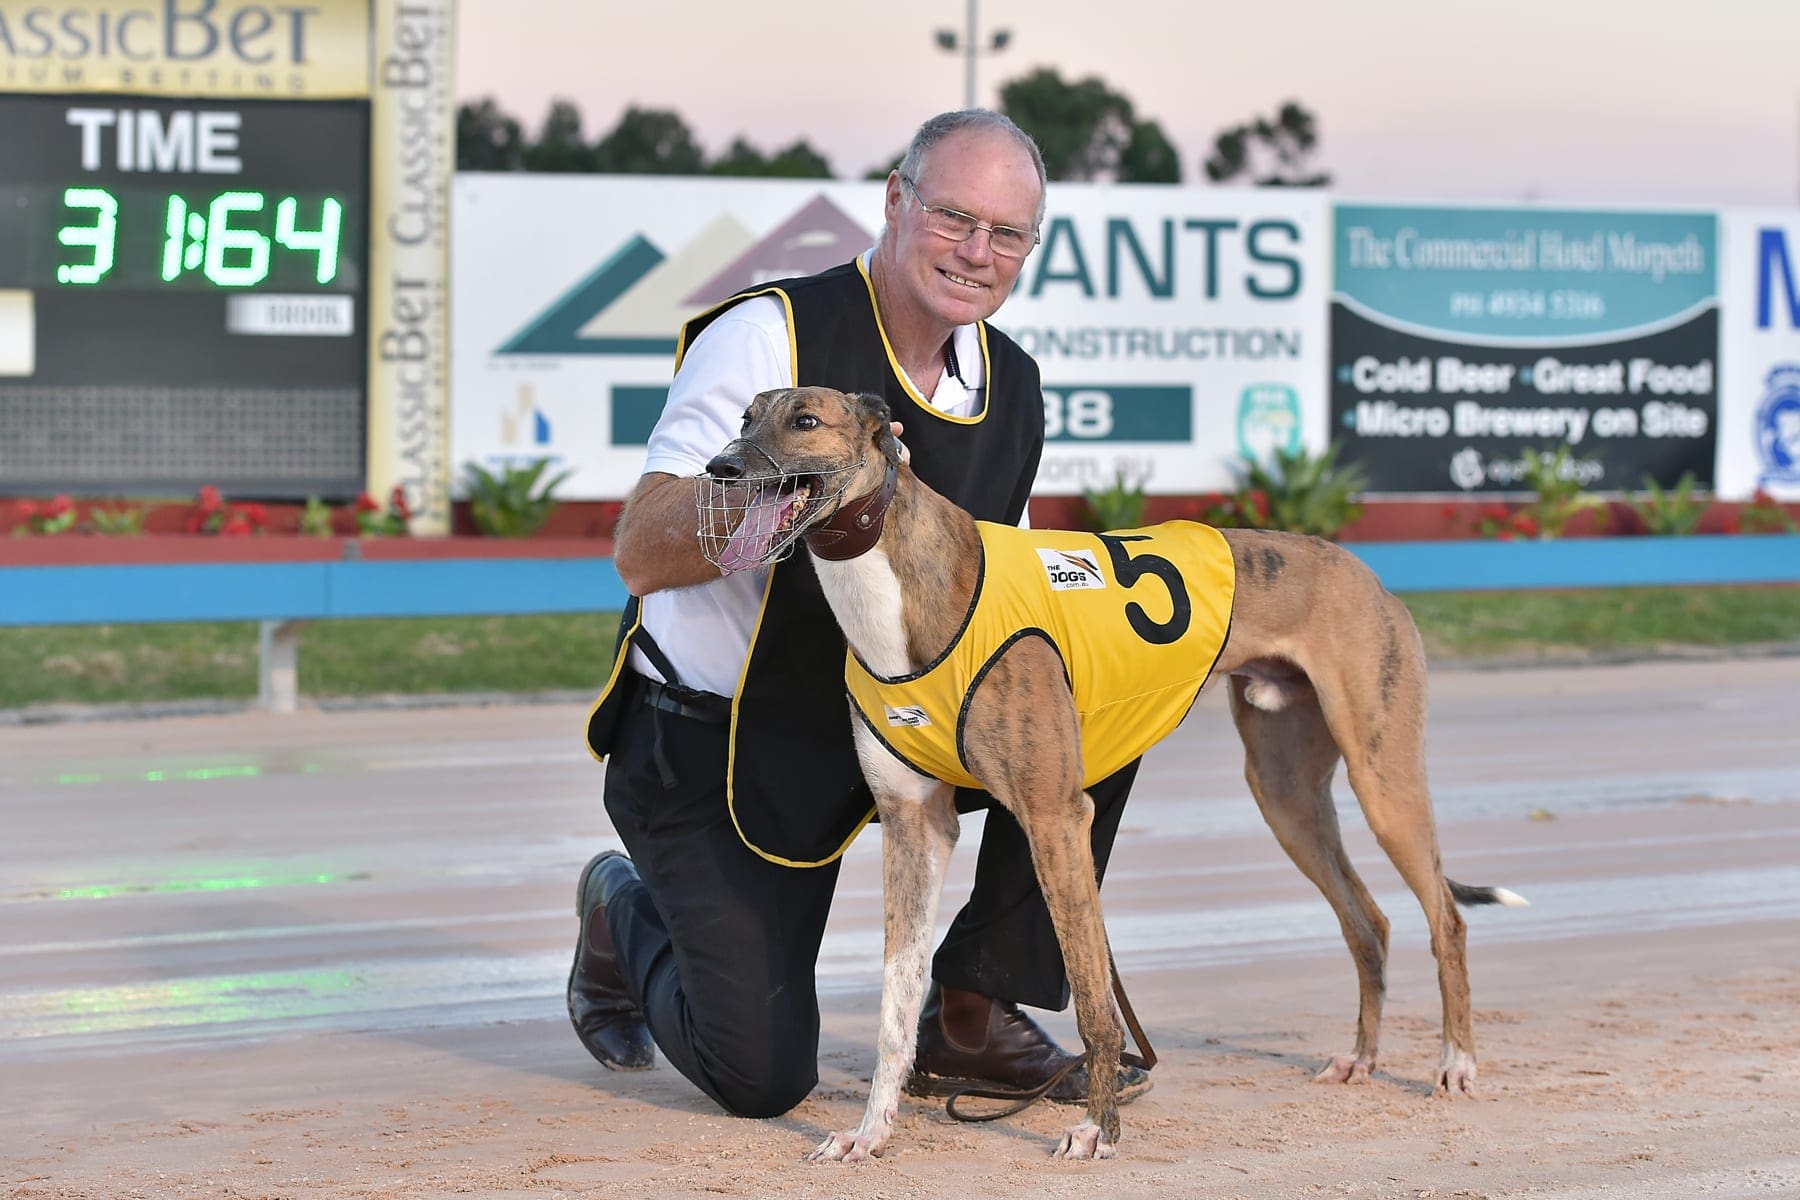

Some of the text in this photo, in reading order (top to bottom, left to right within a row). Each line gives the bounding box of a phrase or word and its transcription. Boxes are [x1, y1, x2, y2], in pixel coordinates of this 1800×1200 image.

[66, 108, 243, 174] TIME
[1010, 217, 1303, 302] ANTS
[1346, 227, 1392, 268] The
[1395, 228, 1535, 272] Commercial
[1540, 229, 1602, 273] Hotel
[1003, 326, 1302, 361] ONSTRUCTION
[1353, 356, 1713, 395] Cold Beer Great Food
[1355, 400, 1708, 445] Micro Brewery on Site
[1096, 532, 1192, 645] 5
